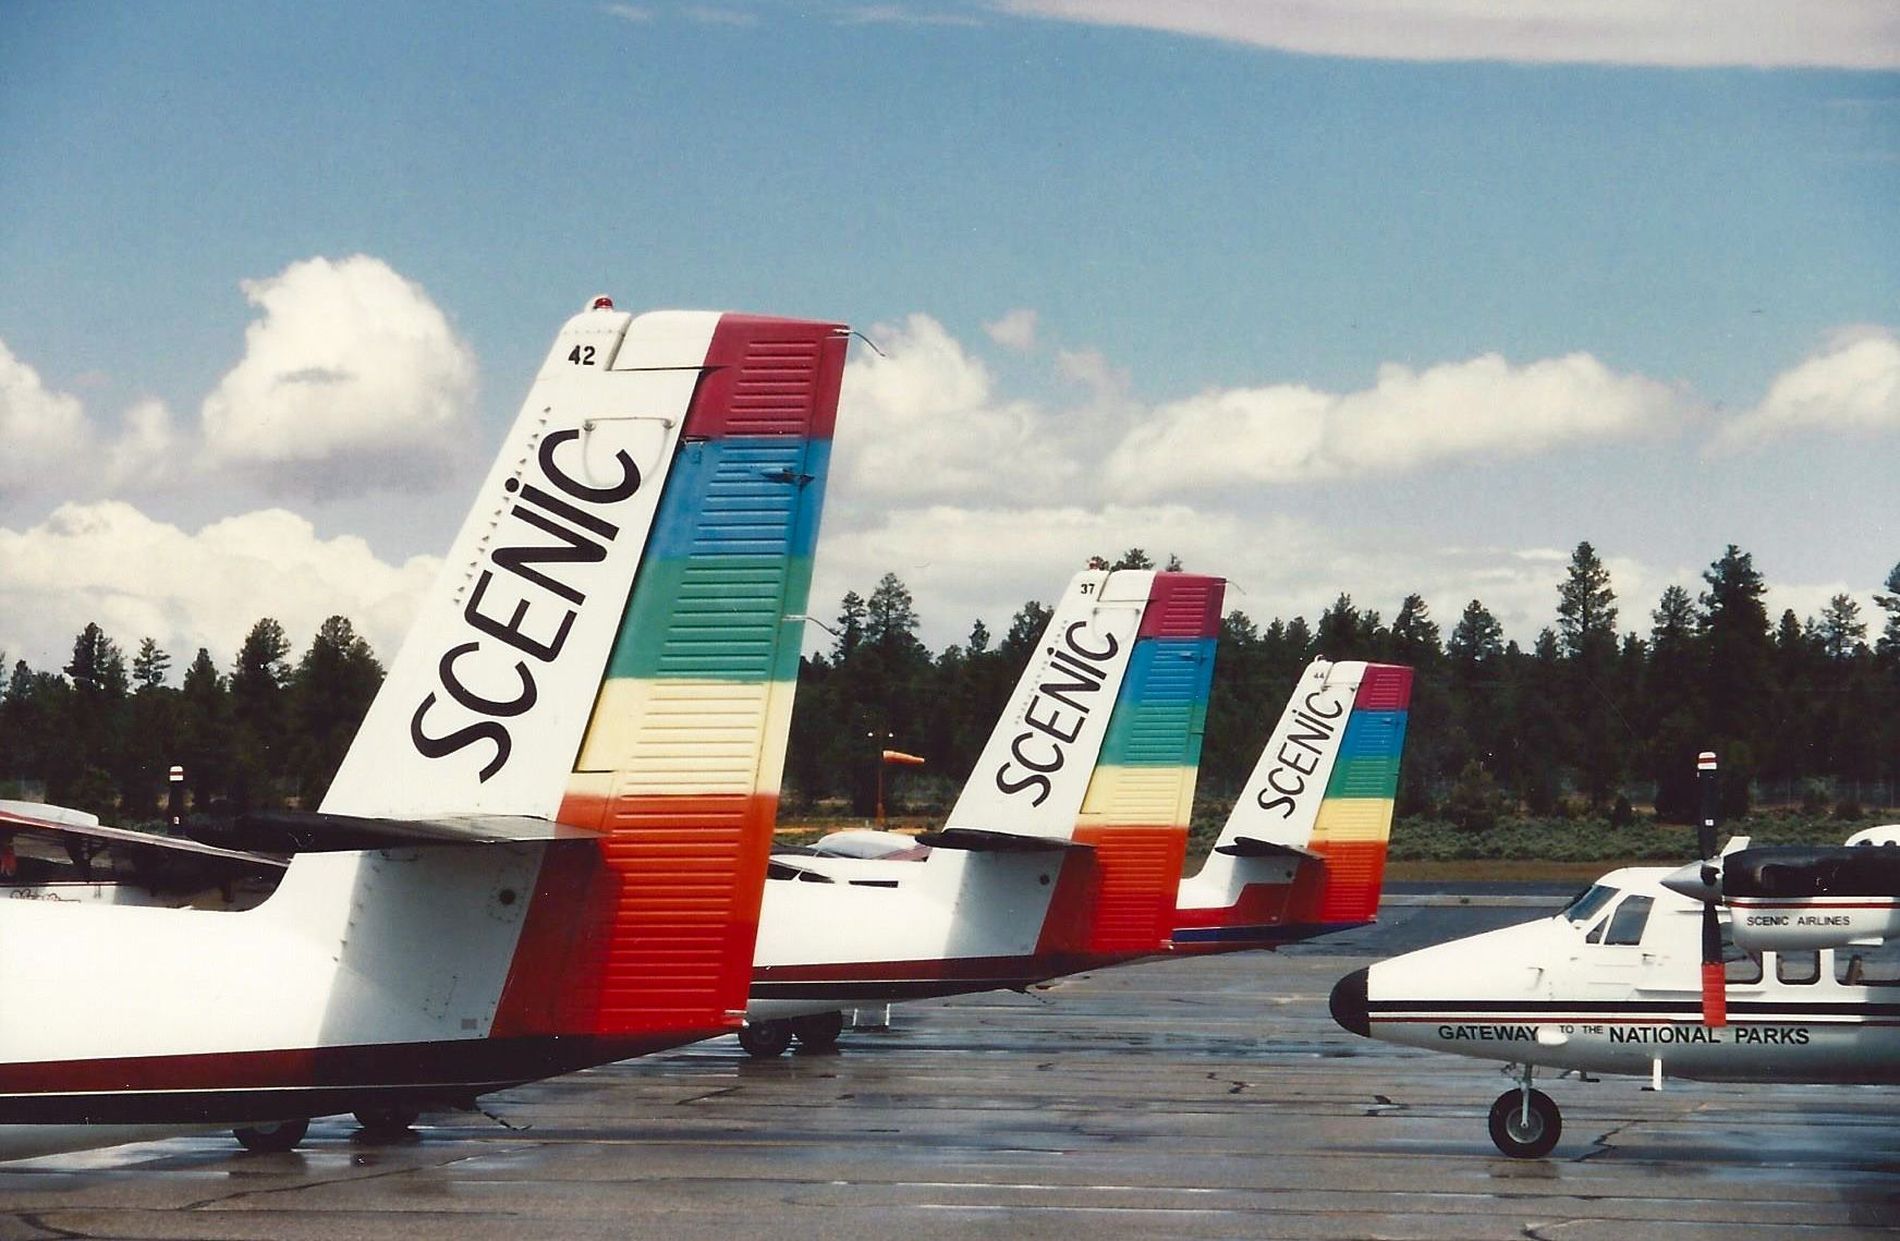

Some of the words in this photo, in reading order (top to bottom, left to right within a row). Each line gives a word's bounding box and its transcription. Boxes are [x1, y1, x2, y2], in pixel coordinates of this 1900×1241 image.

[568, 345, 596, 366] 42
[1080, 582, 1096, 595] 37
[1746, 915, 1789, 926] SCENIC
[1797, 915, 1850, 926] AIRLINES
[1438, 1025, 1539, 1042] GATEWAY
[1559, 1024, 1575, 1035] TO
[1582, 1024, 1604, 1035] THE
[1609, 1026, 1721, 1044] NATIONAL
[1735, 1026, 1810, 1045] PARKS
